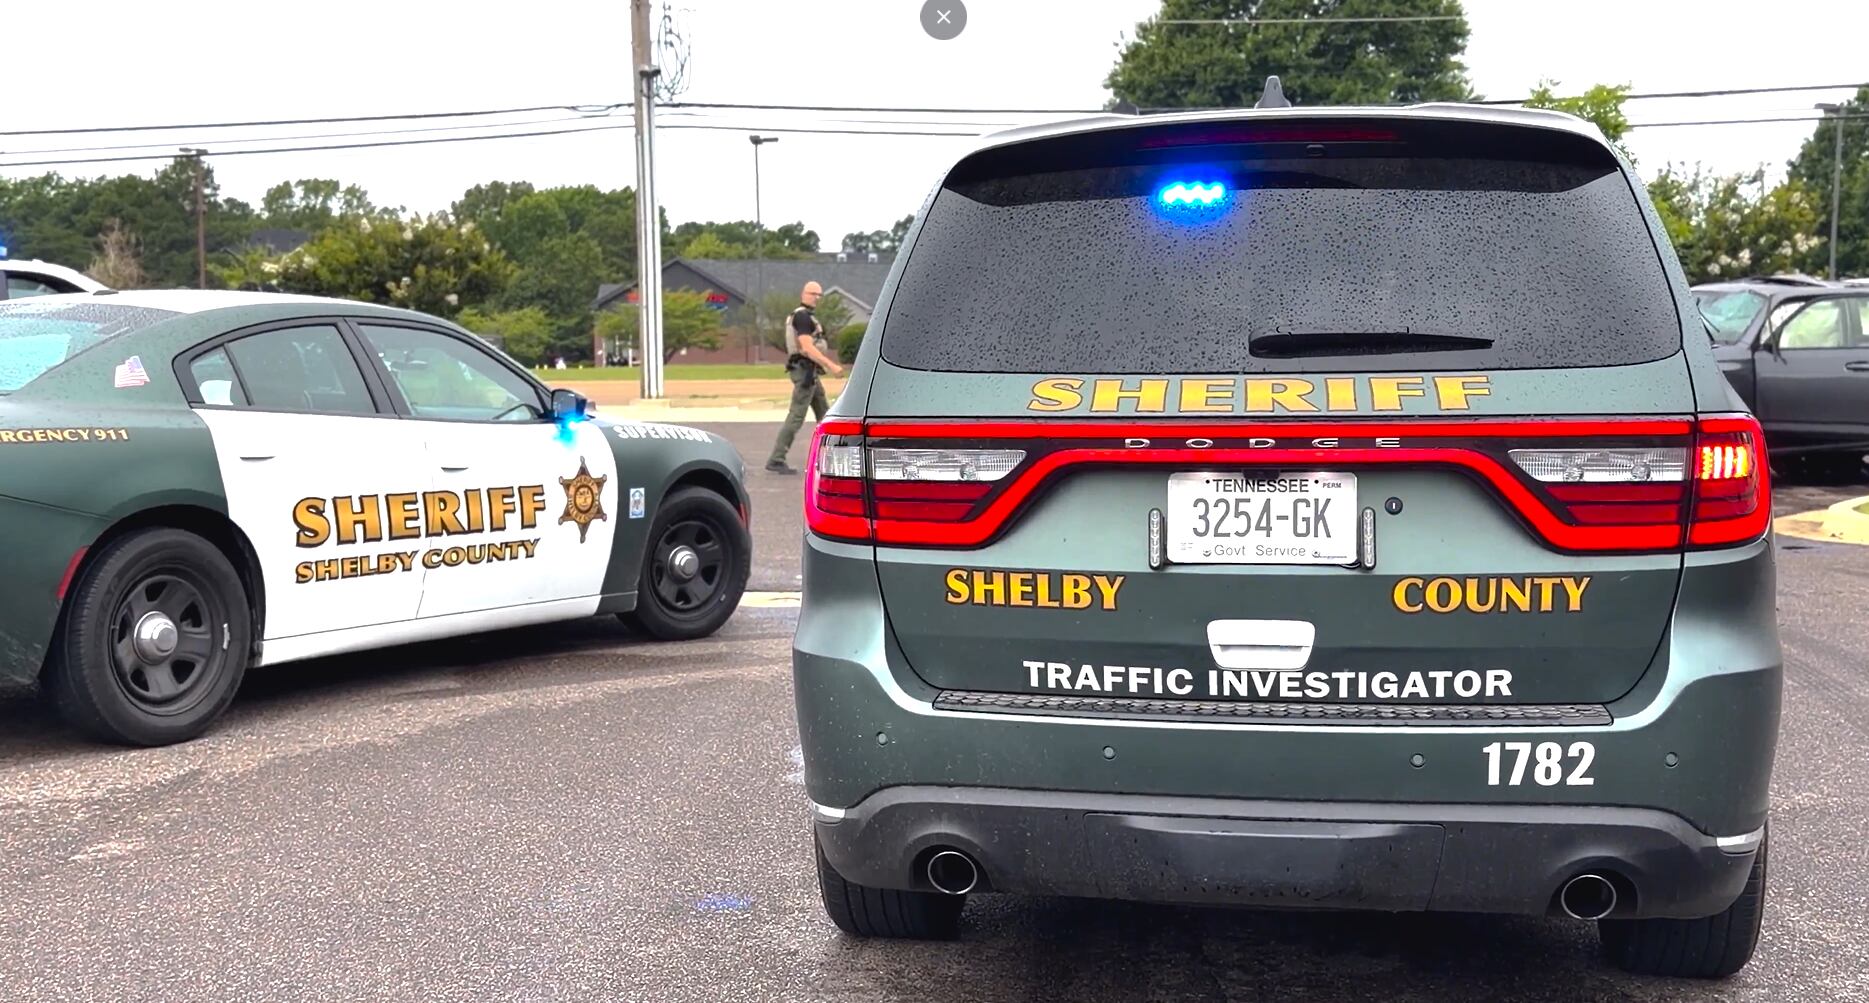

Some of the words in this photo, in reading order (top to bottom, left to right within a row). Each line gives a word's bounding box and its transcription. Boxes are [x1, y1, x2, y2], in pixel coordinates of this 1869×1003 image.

[1027, 375, 1491, 413] SHERIFF
[0, 427, 91, 443] RGENCY
[94, 427, 130, 442] 911
[613, 424, 712, 444] SUPERVISOR
[1124, 437, 1401, 449] DODGE
[1213, 479, 1309, 493] TENNESSEE
[292, 485, 546, 548] SHERIFF
[1192, 498, 1332, 539] 3254-GK
[294, 549, 418, 584] SHELBY
[422, 538, 540, 569] COUNTY
[1214, 544, 1246, 557] Govt
[1255, 544, 1306, 557] Service
[945, 569, 1125, 612] SHELBY
[1392, 576, 1592, 615] COUNTY
[1023, 660, 1193, 696] TRAFFIC
[1209, 669, 1513, 699] INVESTIGATOR
[1482, 741, 1595, 787] 1782
